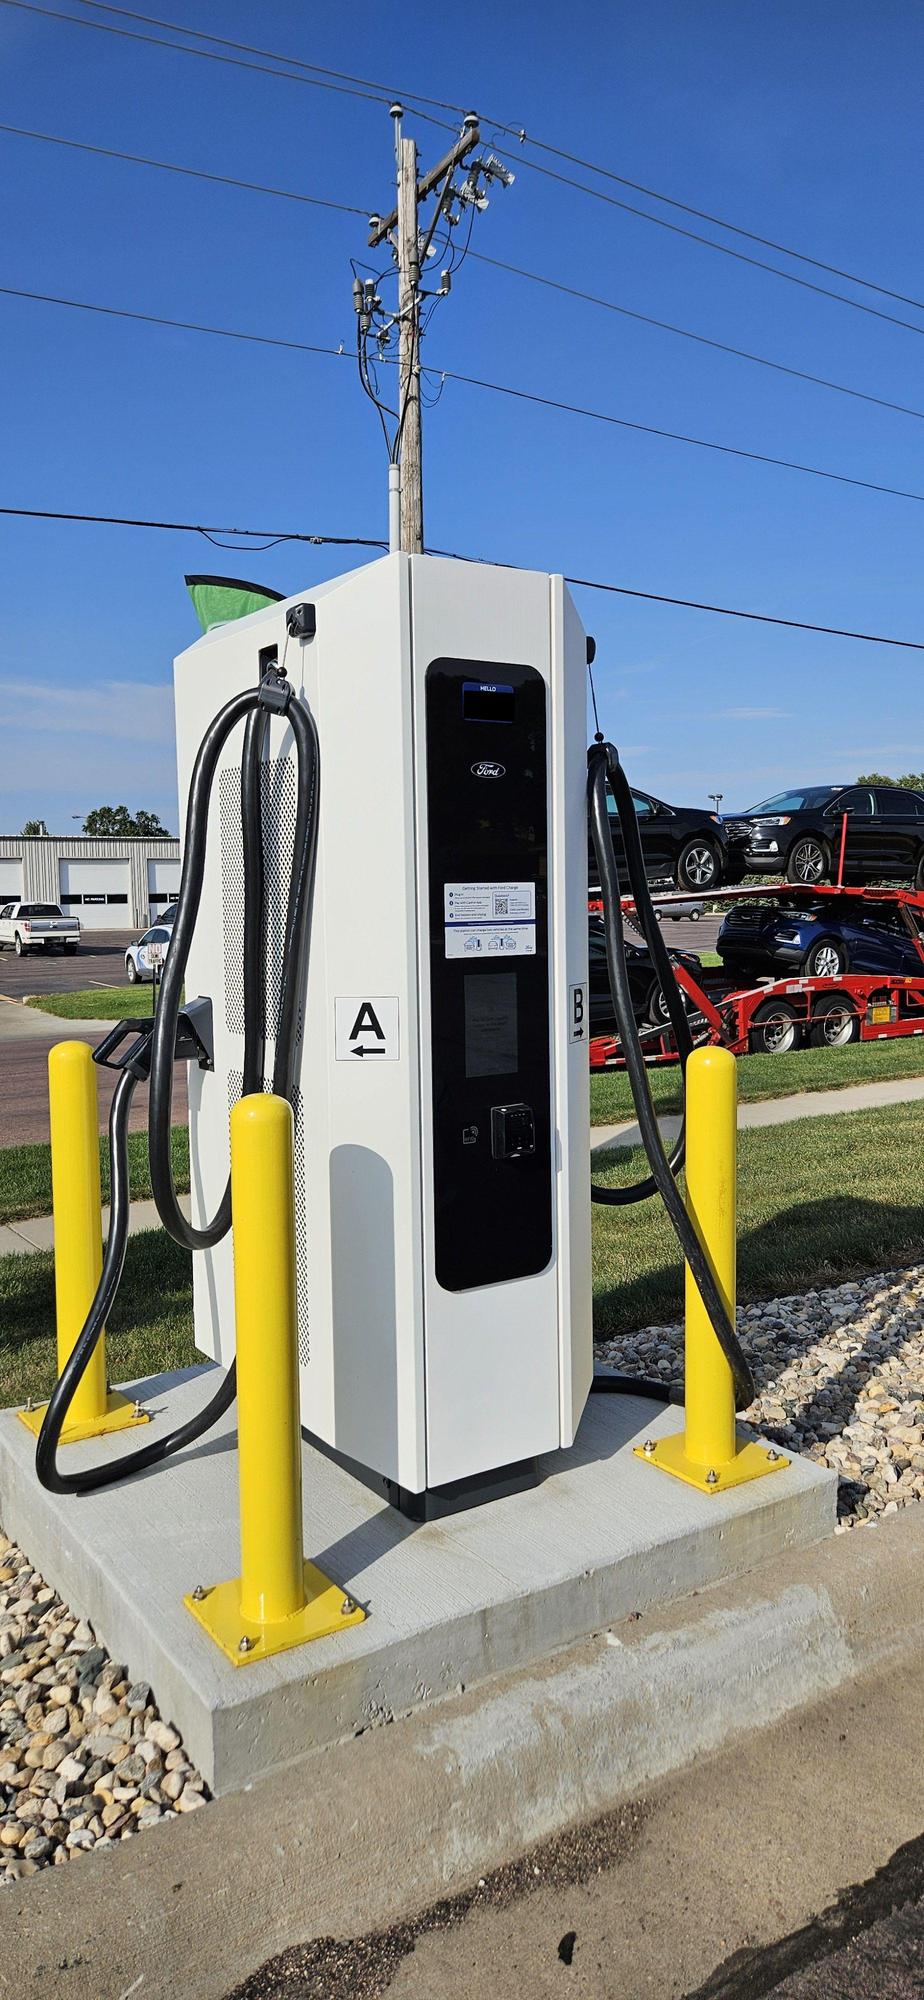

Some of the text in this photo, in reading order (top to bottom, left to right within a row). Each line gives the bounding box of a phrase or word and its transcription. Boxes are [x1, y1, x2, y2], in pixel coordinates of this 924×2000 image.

[477, 763, 500, 776] Ford
[348, 1002, 386, 1040] A
[573, 988, 584, 1024] B
